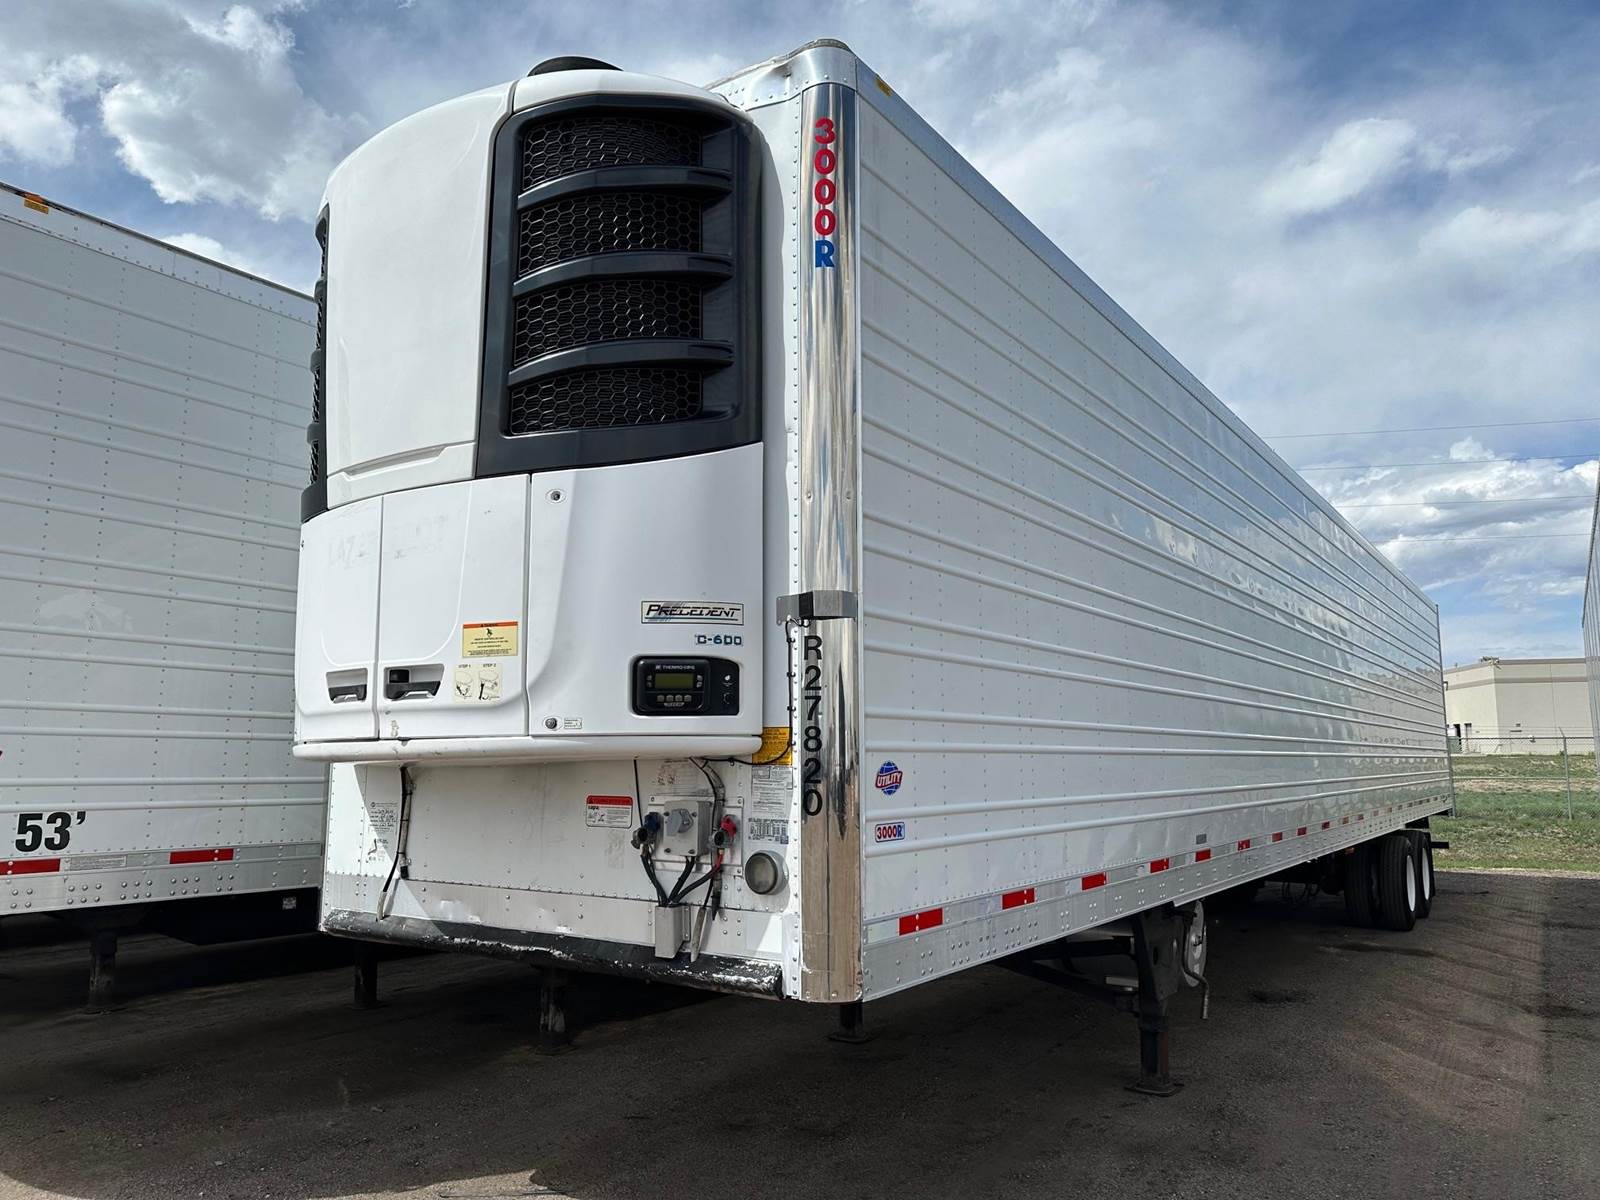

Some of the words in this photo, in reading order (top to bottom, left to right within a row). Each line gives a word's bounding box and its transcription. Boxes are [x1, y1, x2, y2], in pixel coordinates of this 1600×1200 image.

[814, 117, 836, 268] 3000R
[803, 635, 823, 816] R27820
[877, 772, 901, 787] UTILITY
[876, 824, 903, 840] 3000R
